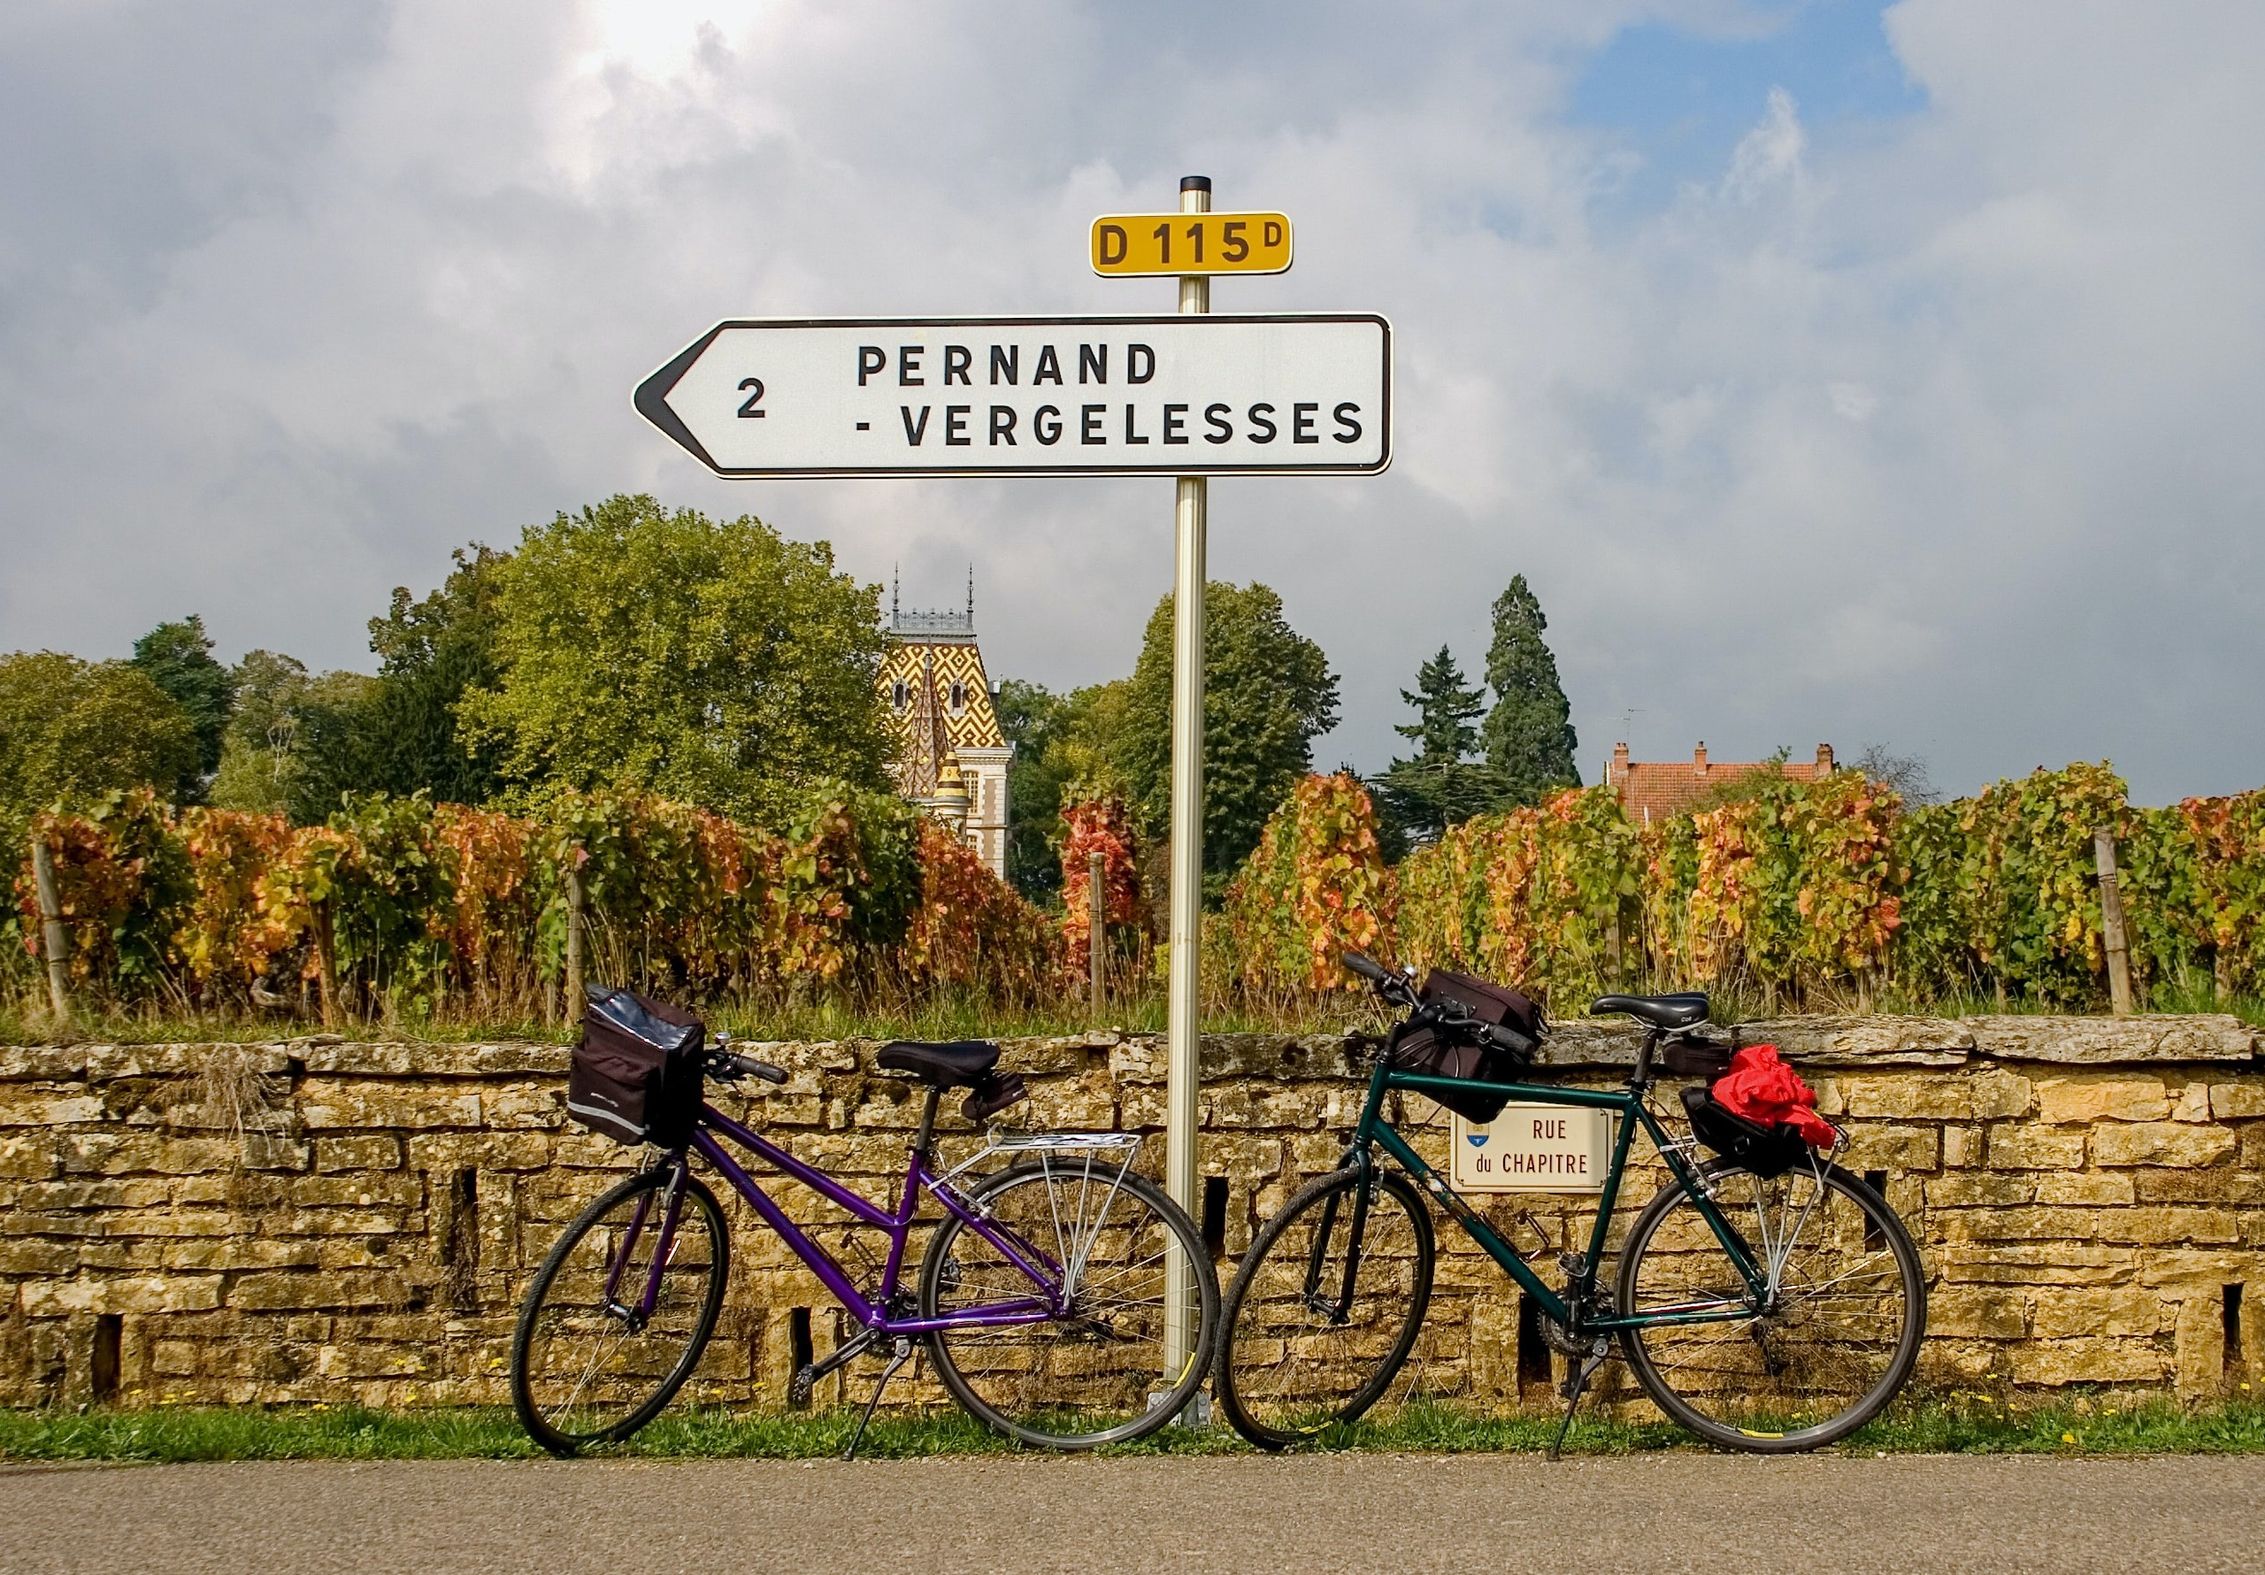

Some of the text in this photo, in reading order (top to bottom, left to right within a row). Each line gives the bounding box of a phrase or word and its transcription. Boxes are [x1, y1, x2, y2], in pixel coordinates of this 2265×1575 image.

[1100, 224, 1128, 265] D
[858, 343, 1156, 386] PERNAND
[737, 377, 766, 419] 2
[1533, 1120, 1566, 1139] RUE
[1476, 1153, 1587, 1174] du CHAPITRE
